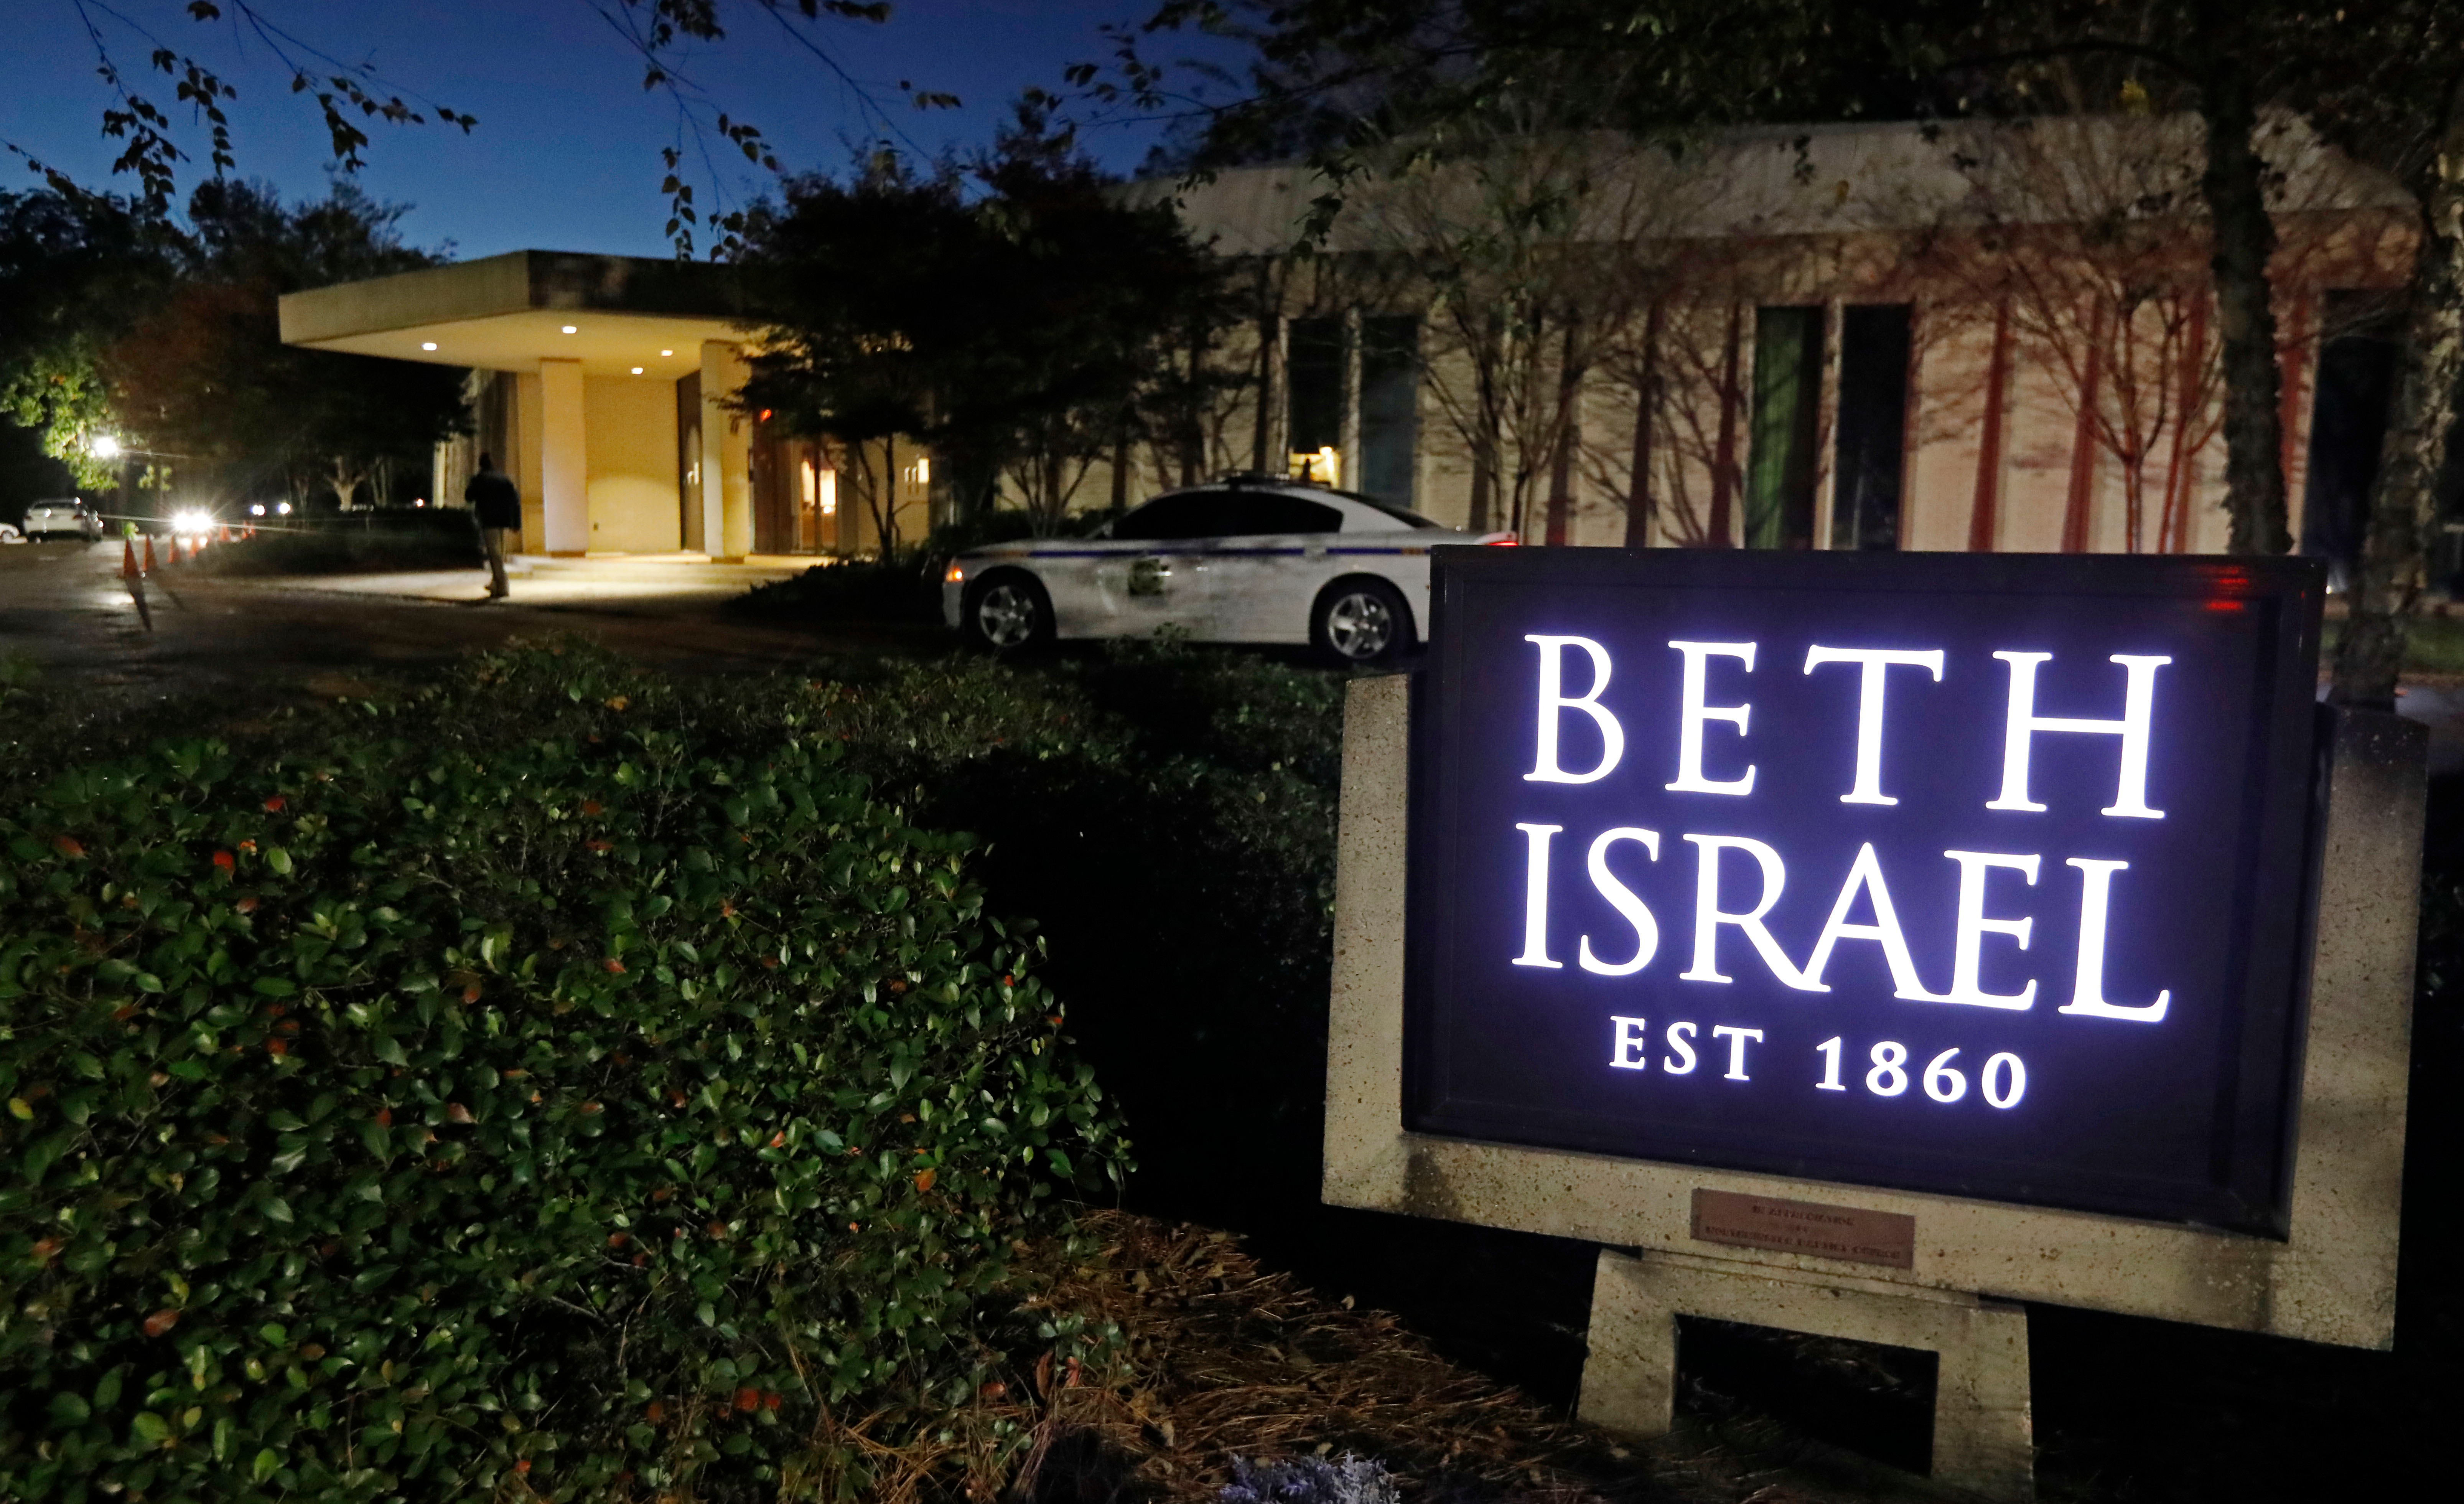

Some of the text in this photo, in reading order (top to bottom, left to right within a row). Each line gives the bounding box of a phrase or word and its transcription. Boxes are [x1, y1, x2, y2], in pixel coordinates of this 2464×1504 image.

[1523, 634, 2172, 819] BETH
[1512, 823, 2170, 1022] ISRAEL
[1609, 1016, 2026, 1109] EST 1860
